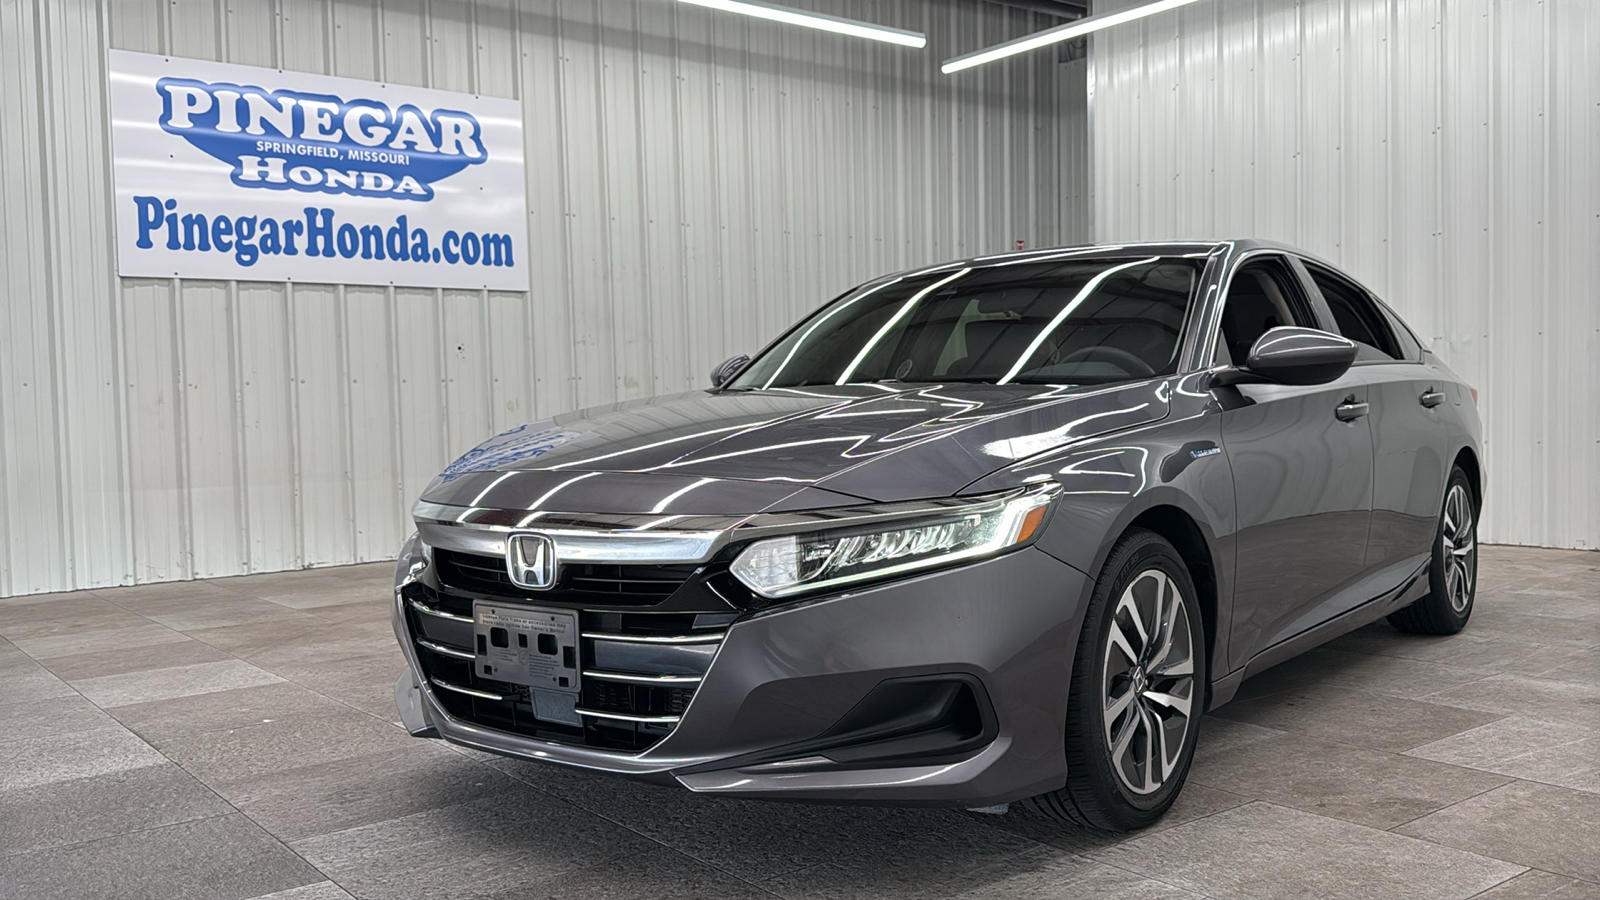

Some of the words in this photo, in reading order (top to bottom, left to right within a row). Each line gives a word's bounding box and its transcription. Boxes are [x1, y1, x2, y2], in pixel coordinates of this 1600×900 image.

[164, 85, 482, 158] PINEGAR
[237, 155, 428, 195] HONDA
[256, 140, 344, 161] SPRINGFIELD,
[348, 150, 410, 165] MISSOURI
[133, 196, 515, 267] PinegarHonda.com
